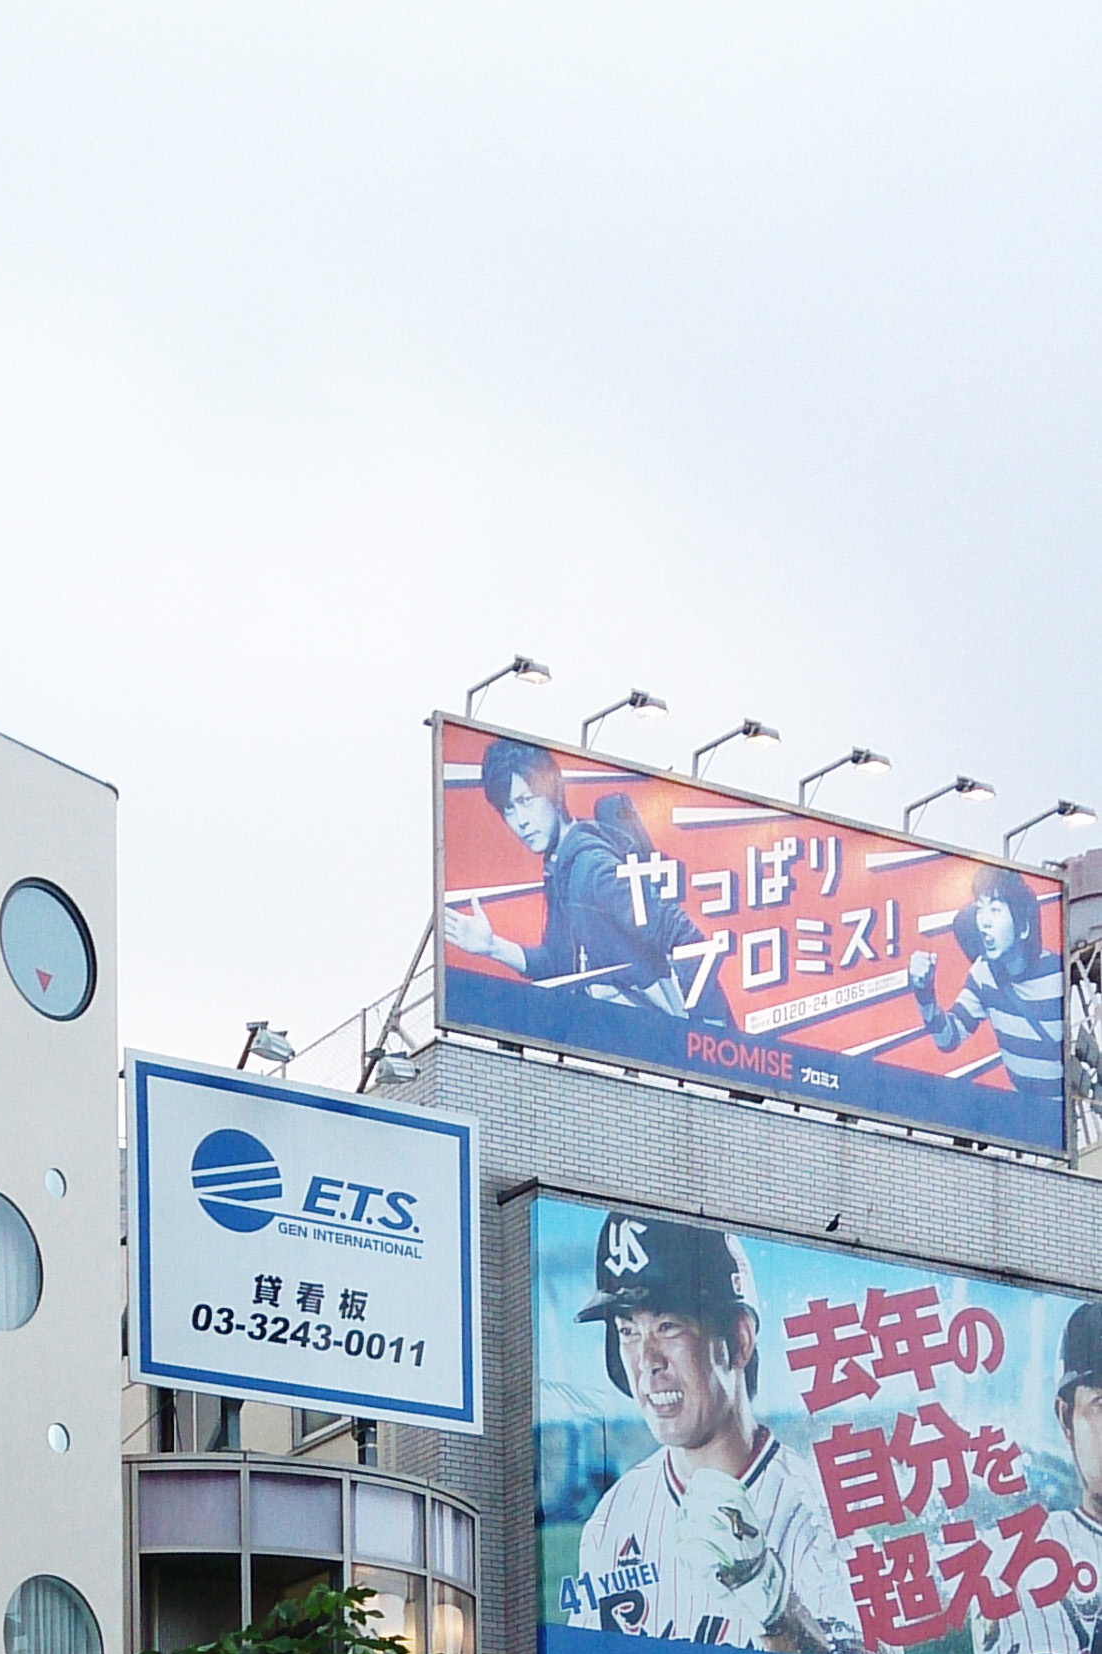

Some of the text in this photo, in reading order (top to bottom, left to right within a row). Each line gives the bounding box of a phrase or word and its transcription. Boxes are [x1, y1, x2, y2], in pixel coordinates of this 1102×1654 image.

[617, 836, 836, 926] やっぱり
[673, 899, 895, 1009] プロミス!
[773, 985, 865, 1023] 0120-24-0365
[687, 1032, 793, 1081] PROMISE
[801, 1066, 840, 1090] プロミス
[302, 1175, 420, 1234] E.T.S.
[278, 1221, 422, 1260] GEN INTERNATIONAL
[252, 1273, 368, 1322] 貸看板
[191, 1302, 426, 1368] 03-3243-0011
[784, 1286, 1005, 1415] 去年の
[813, 1403, 1027, 1539] 自分を
[560, 1562, 660, 1615] 41 YUHEI
[848, 1504, 1098, 1652] 超えろ。
